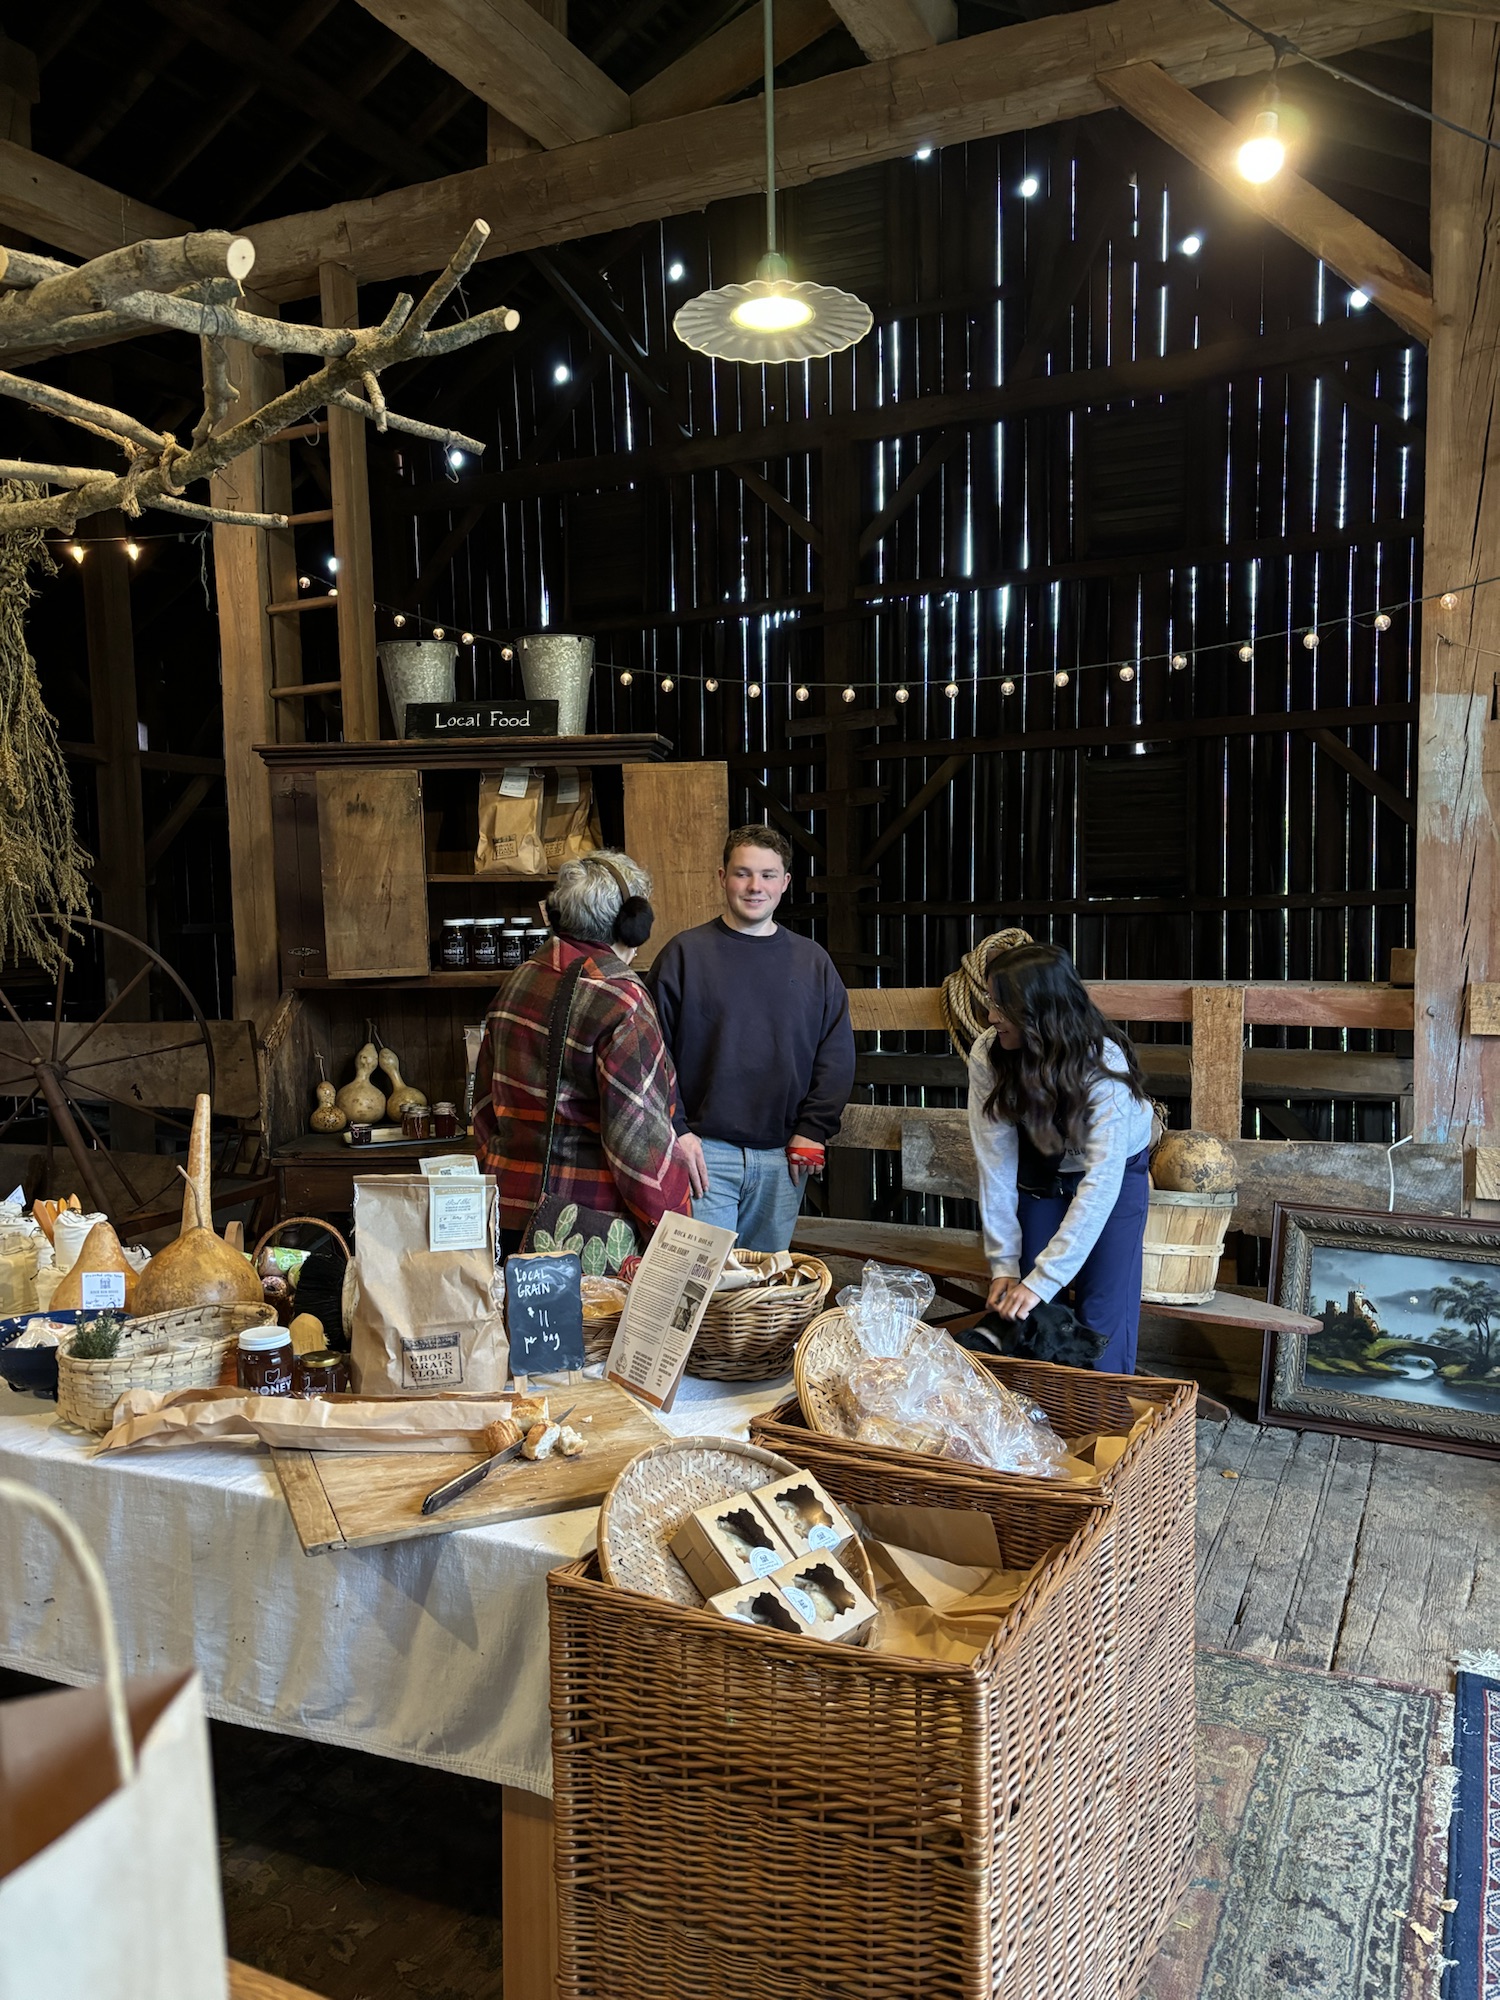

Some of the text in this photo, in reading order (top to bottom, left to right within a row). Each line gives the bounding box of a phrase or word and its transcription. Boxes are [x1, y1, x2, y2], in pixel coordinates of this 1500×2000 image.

[435, 709, 531, 729] Local Food
[514, 1267, 550, 1283] LOCAL
[691, 1263, 714, 1281] GROWN
[517, 1282, 550, 1298] GRAIN
[524, 1331, 560, 1354] per bag
[409, 1352, 452, 1362] WHOLE
[410, 1359, 452, 1370] GRAIN
[411, 1367, 454, 1378] FLOUR
[250, 1380, 291, 1396] HONEY
